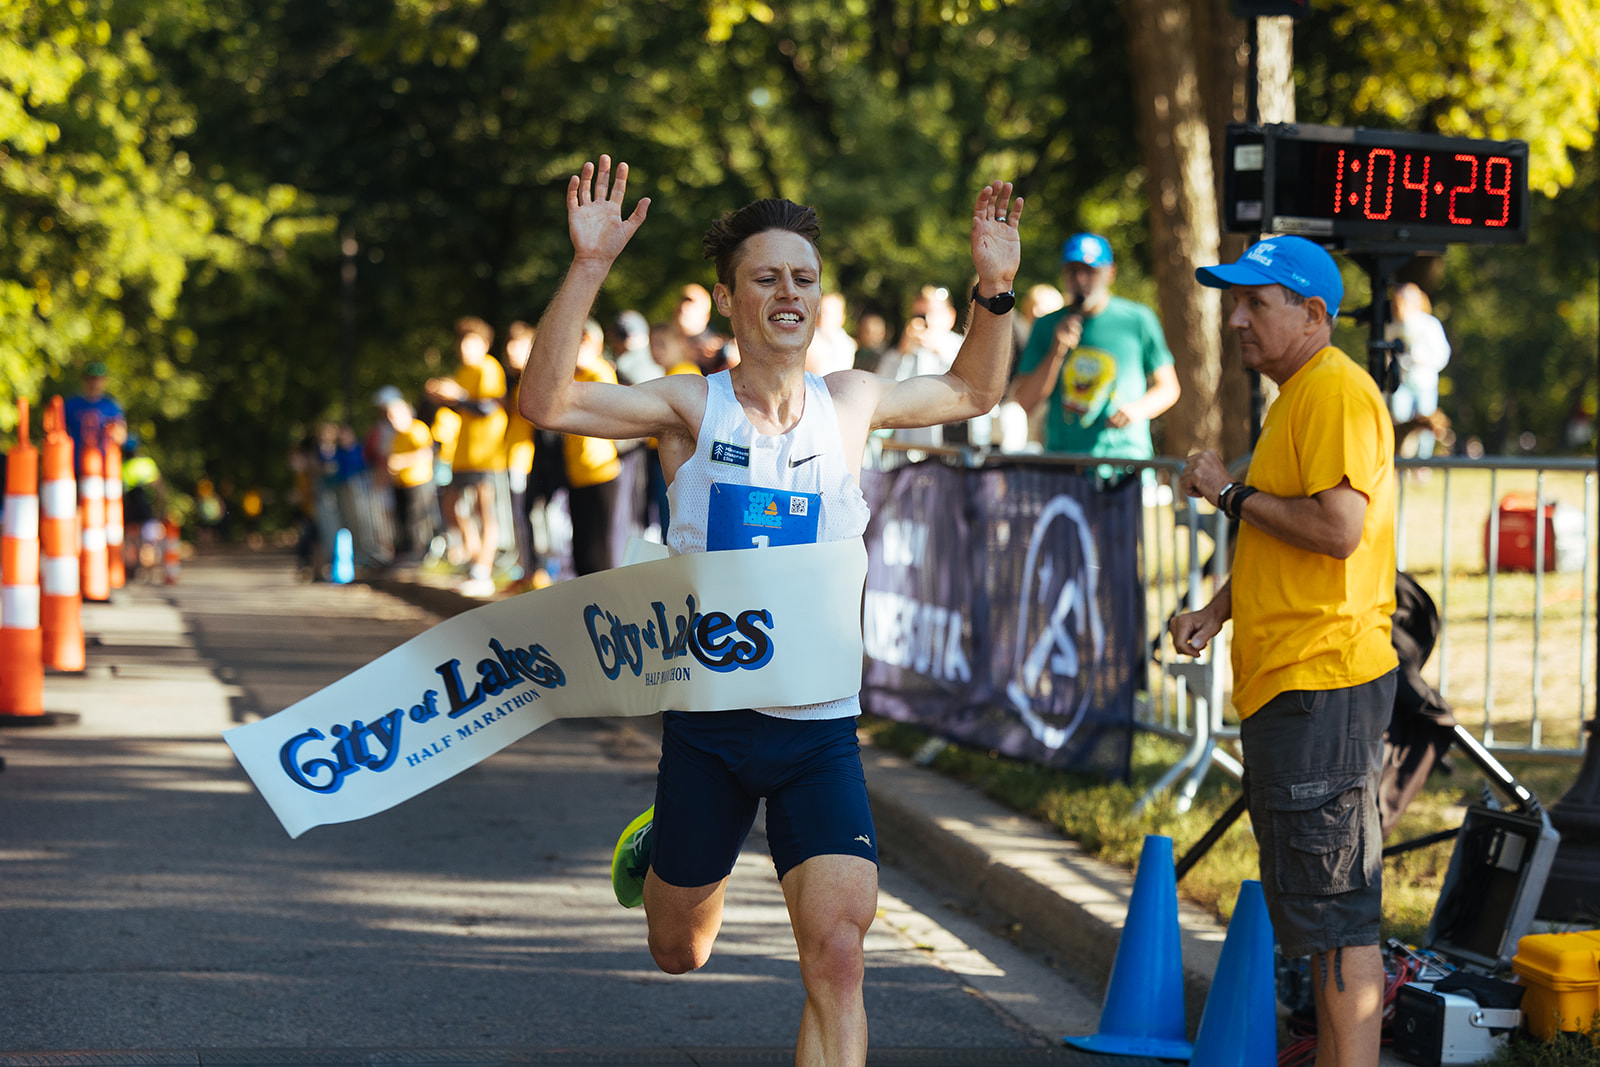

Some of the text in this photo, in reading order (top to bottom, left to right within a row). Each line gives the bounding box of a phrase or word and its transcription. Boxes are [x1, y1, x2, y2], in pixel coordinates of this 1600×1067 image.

[583, 594, 775, 681] City of Lakes
[279, 637, 567, 795] City of Lakes
[405, 688, 542, 768] HALF MARATHON
